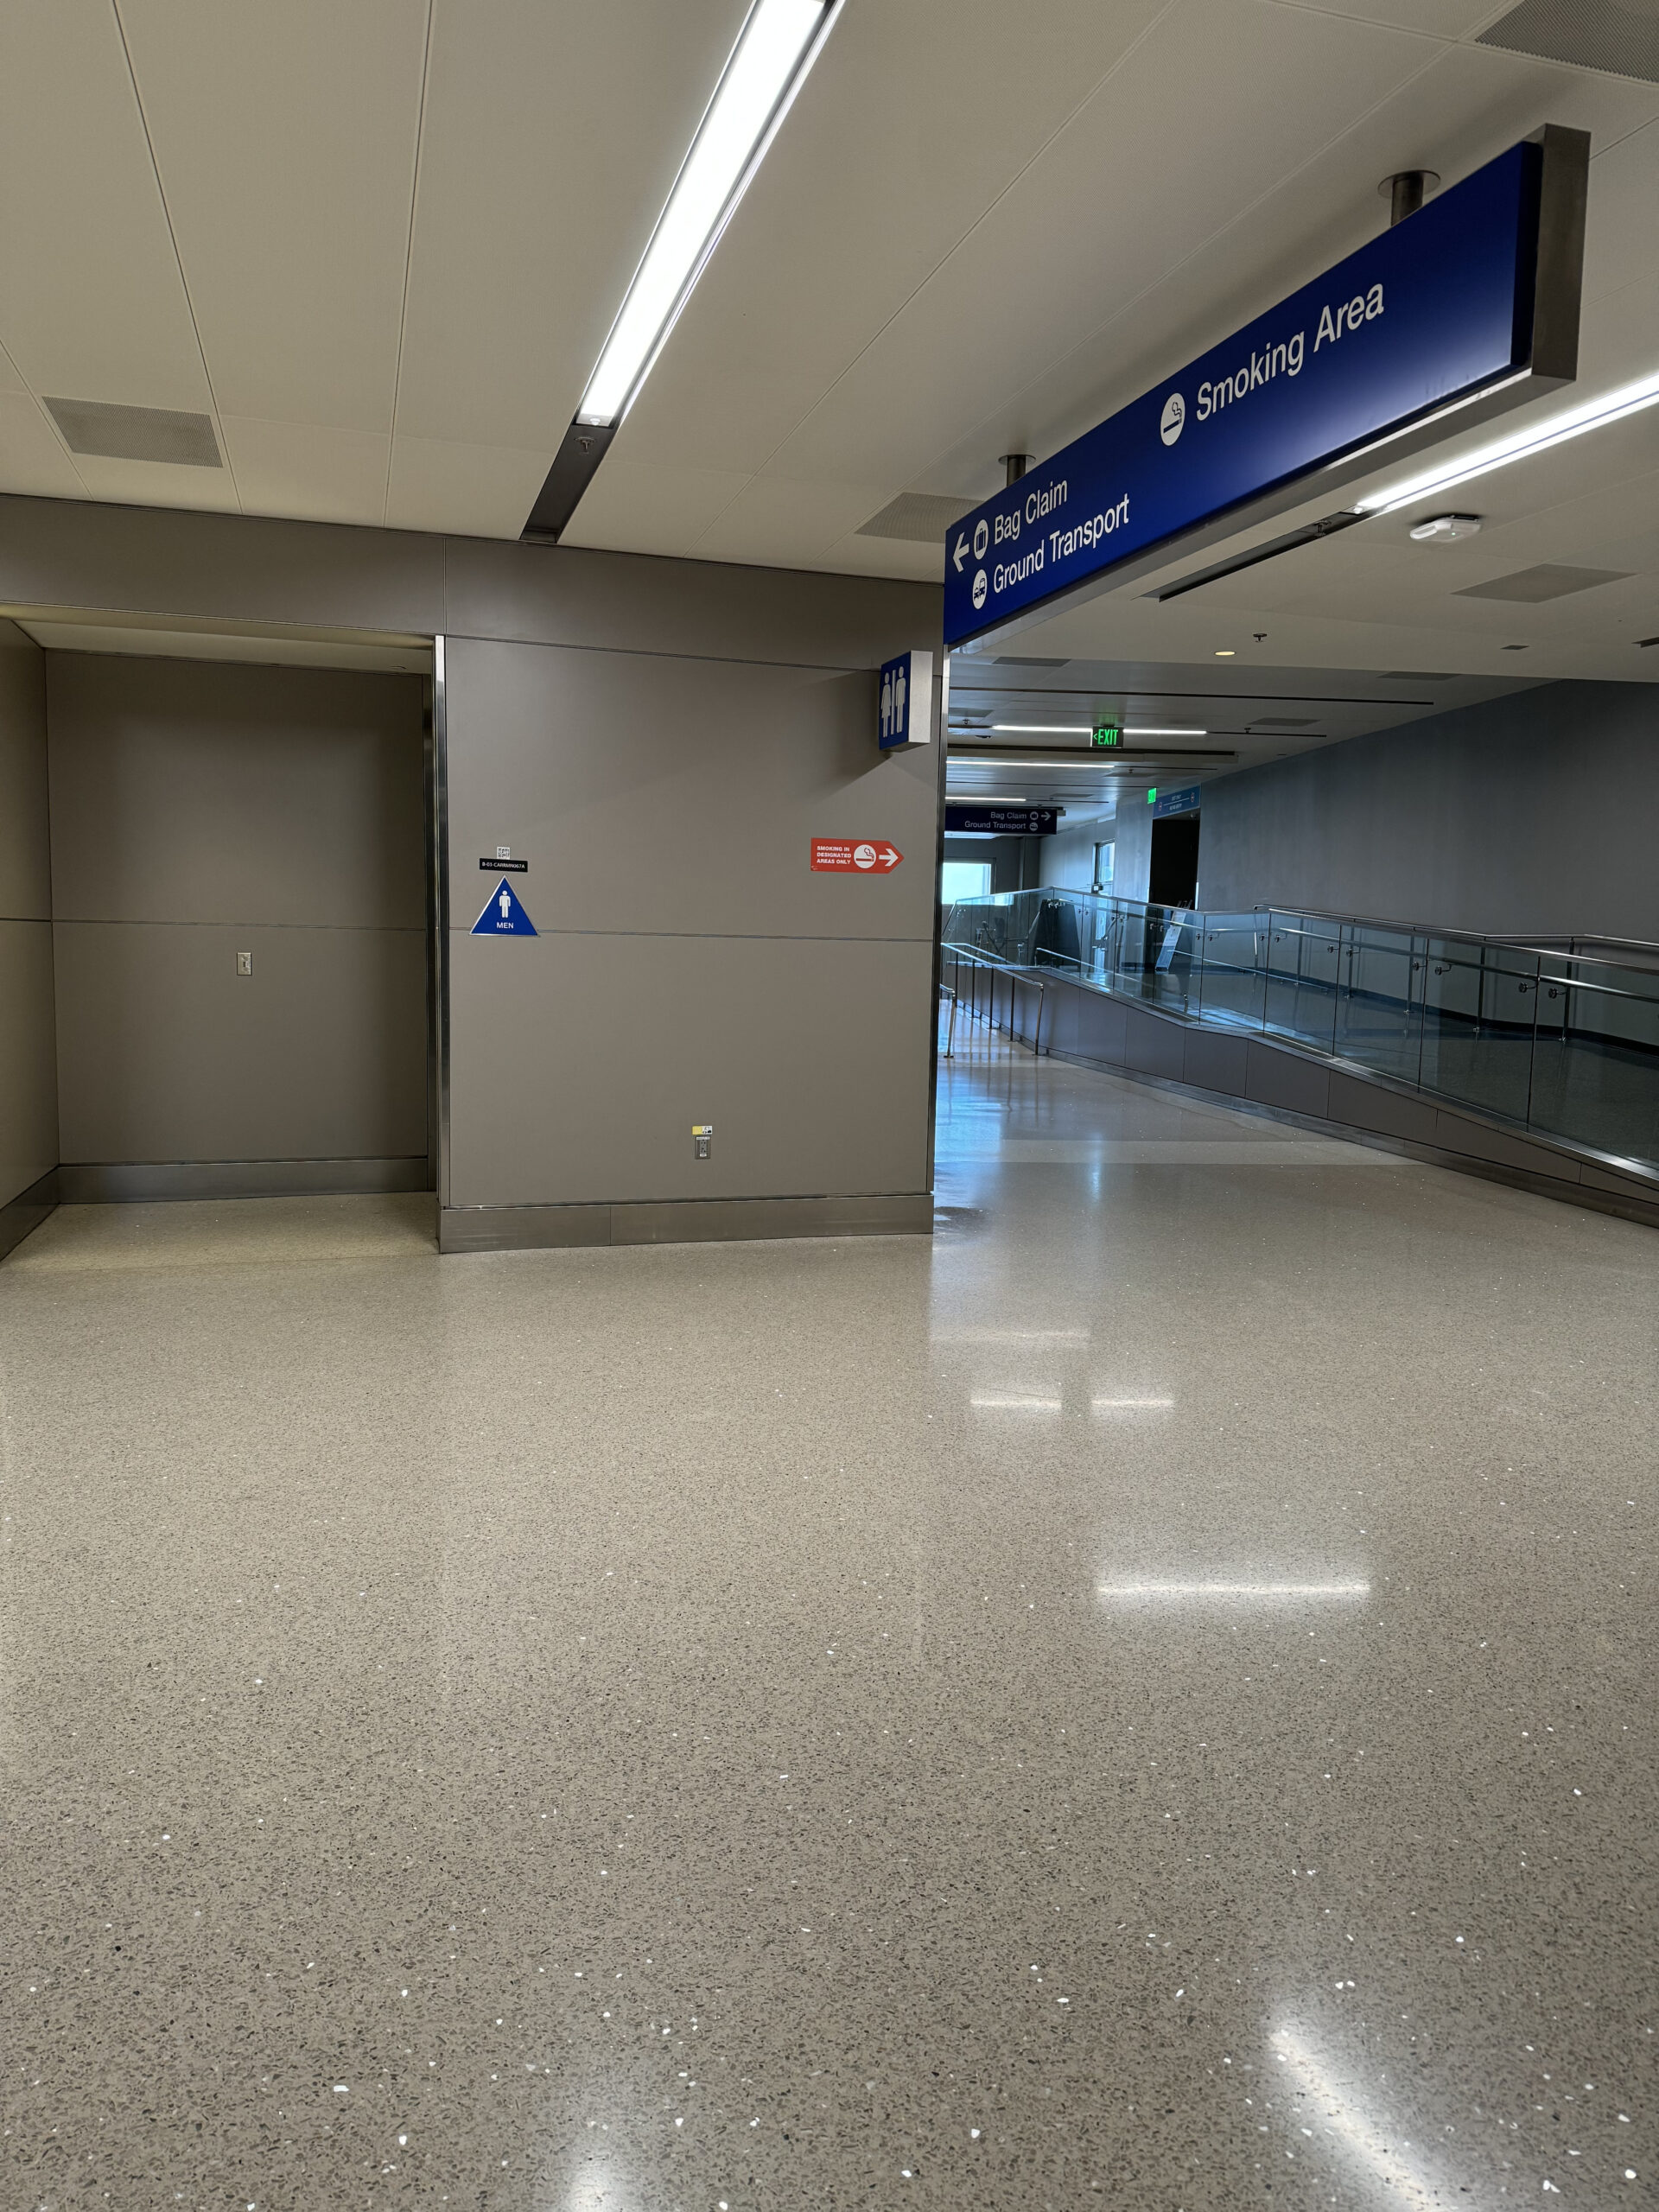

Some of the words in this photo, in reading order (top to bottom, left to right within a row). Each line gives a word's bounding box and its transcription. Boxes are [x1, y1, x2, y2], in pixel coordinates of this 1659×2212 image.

[1197, 332, 1305, 421] Smoking
[1313, 283, 1384, 353] Area
[995, 509, 1020, 545] Bag
[1026, 480, 1067, 524] Claim
[994, 539, 1045, 593] Ground
[1049, 493, 1129, 563] Transport
[1097, 728, 1119, 746] EXIT
[964, 820, 991, 829] Ground
[993, 821, 1027, 830] Transport
[990, 811, 1005, 820] Bag
